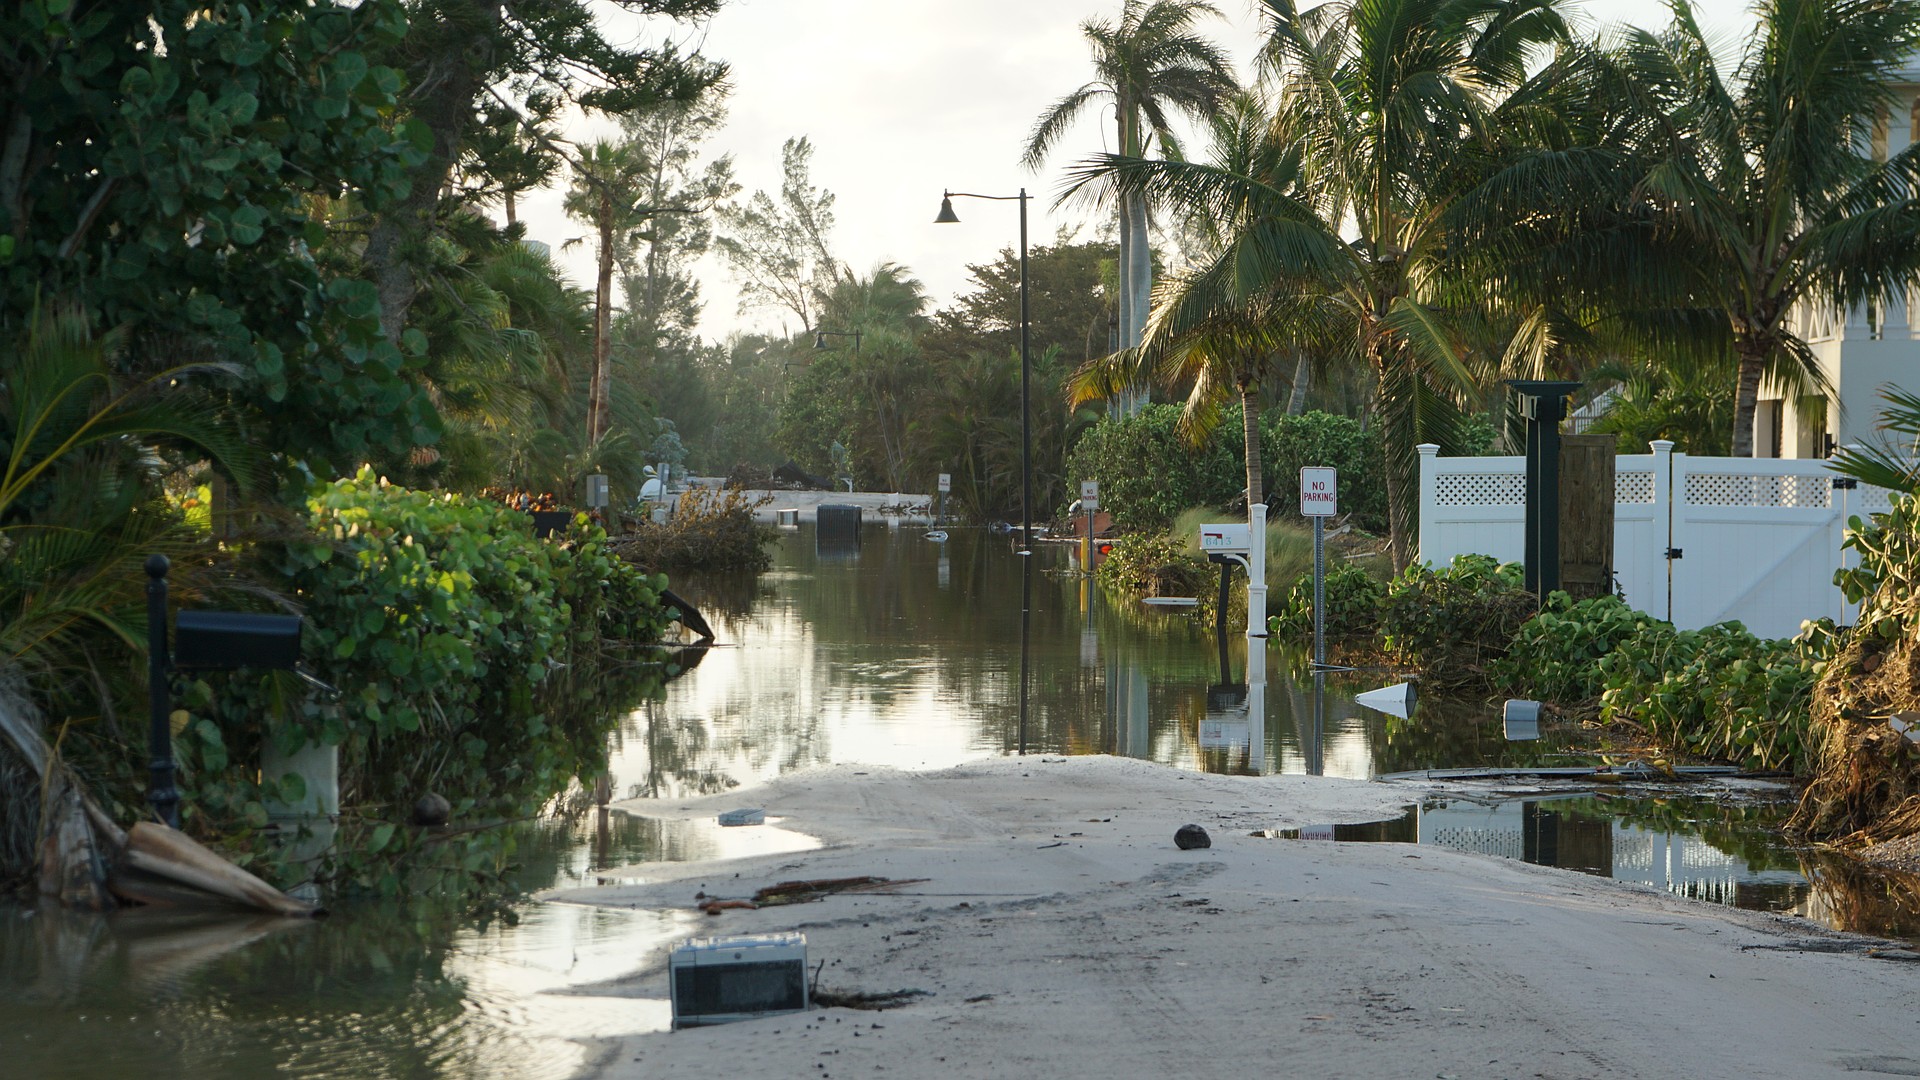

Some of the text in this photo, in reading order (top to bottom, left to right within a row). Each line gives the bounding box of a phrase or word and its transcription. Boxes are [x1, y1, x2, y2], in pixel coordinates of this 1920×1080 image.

[1312, 481, 1325, 491] NO
[1303, 492, 1334, 502] PARKING
[1205, 537, 1232, 546] 6413
